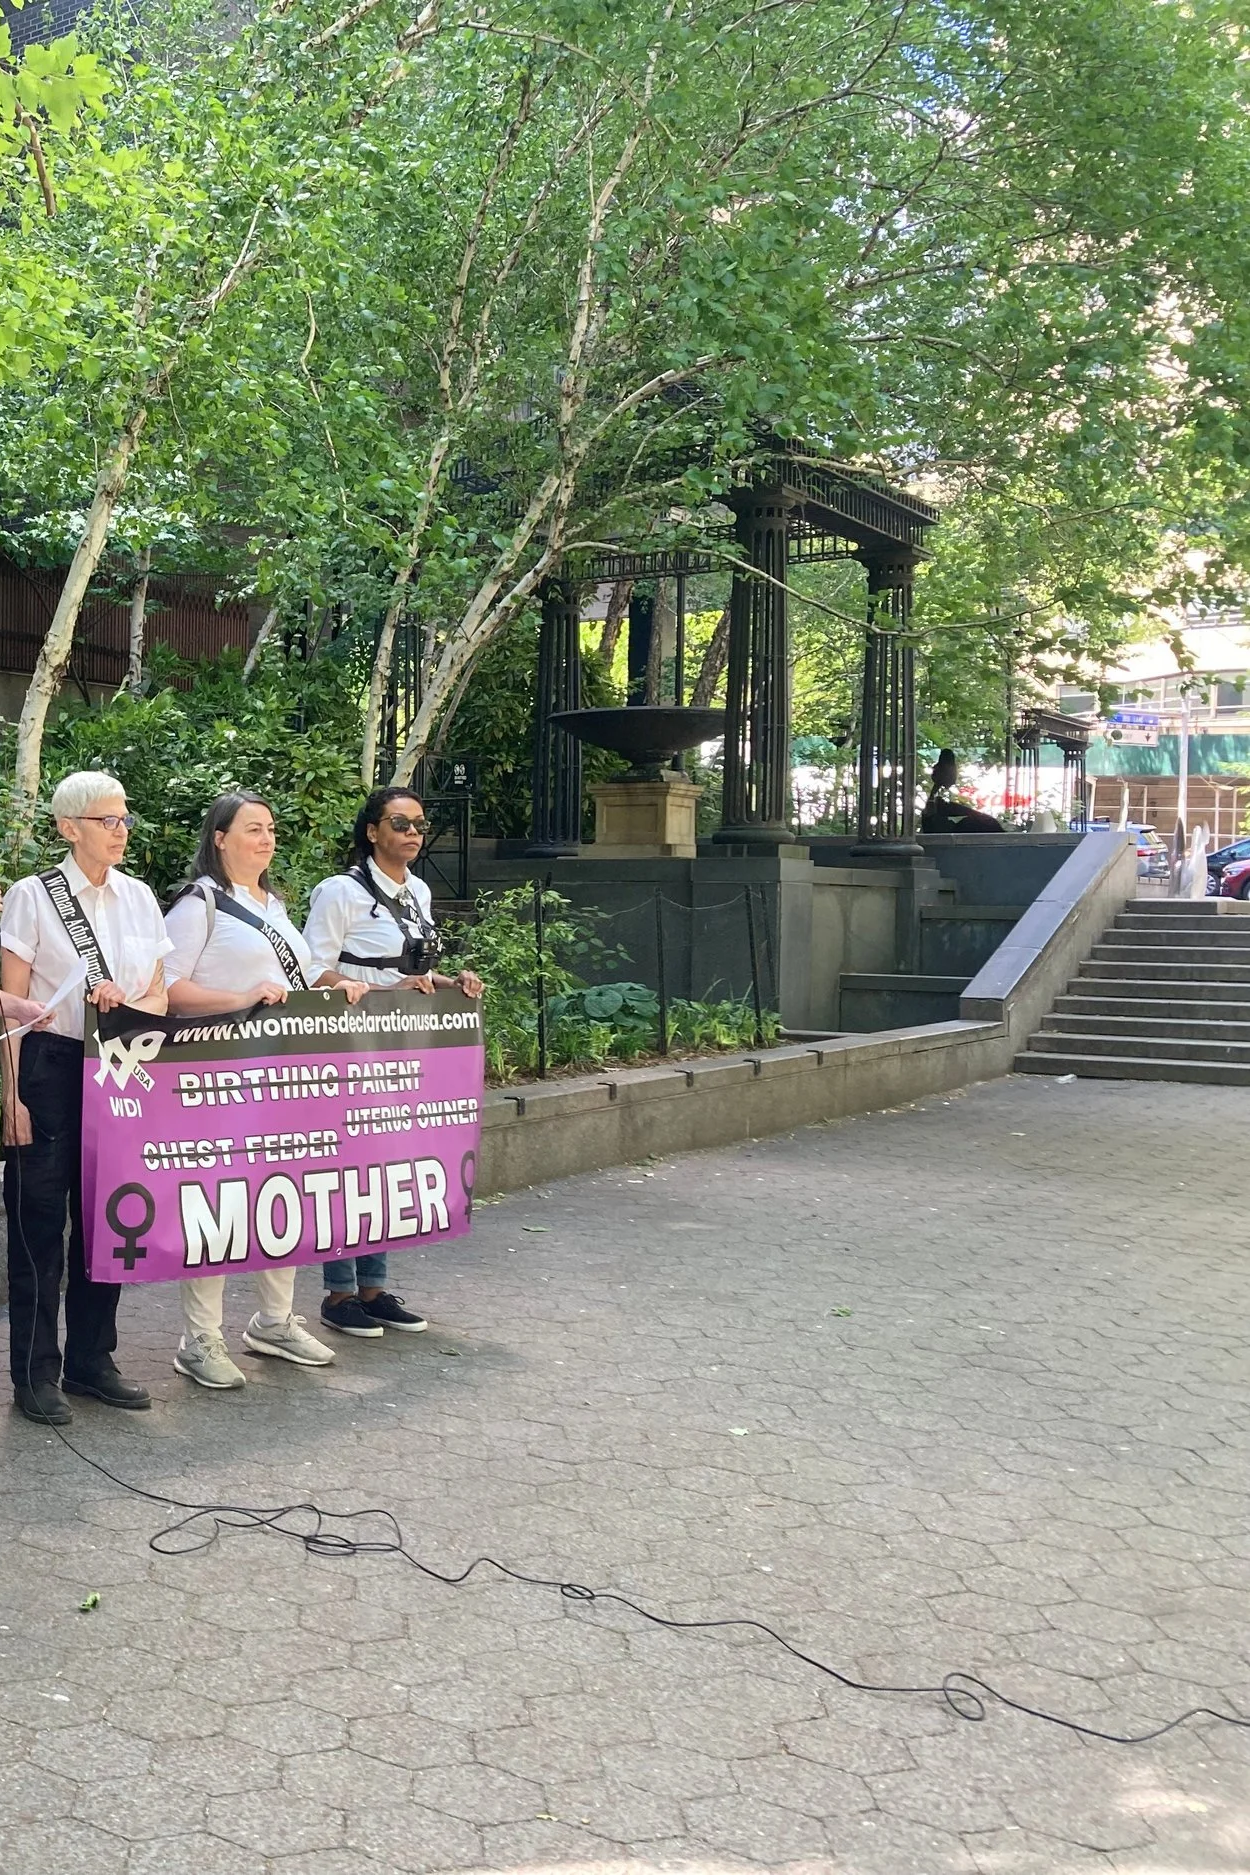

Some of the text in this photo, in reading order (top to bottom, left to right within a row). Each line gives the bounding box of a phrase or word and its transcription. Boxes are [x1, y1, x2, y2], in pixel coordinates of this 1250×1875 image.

[45, 875, 76, 919] Woman:
[65, 919, 94, 949] Adult
[261, 922, 294, 972] Mother:
[173, 1009, 480, 1044] www.womensdeclarationusa.com
[133, 1065, 151, 1088] USA
[178, 1060, 421, 1107] BIRTHING PARENT
[109, 1096, 143, 1118] WDI
[345, 1098, 478, 1137] UTERUS OWNER
[143, 1129, 339, 1171] CHEST FEEDER
[179, 1156, 450, 1268] MOTHER
